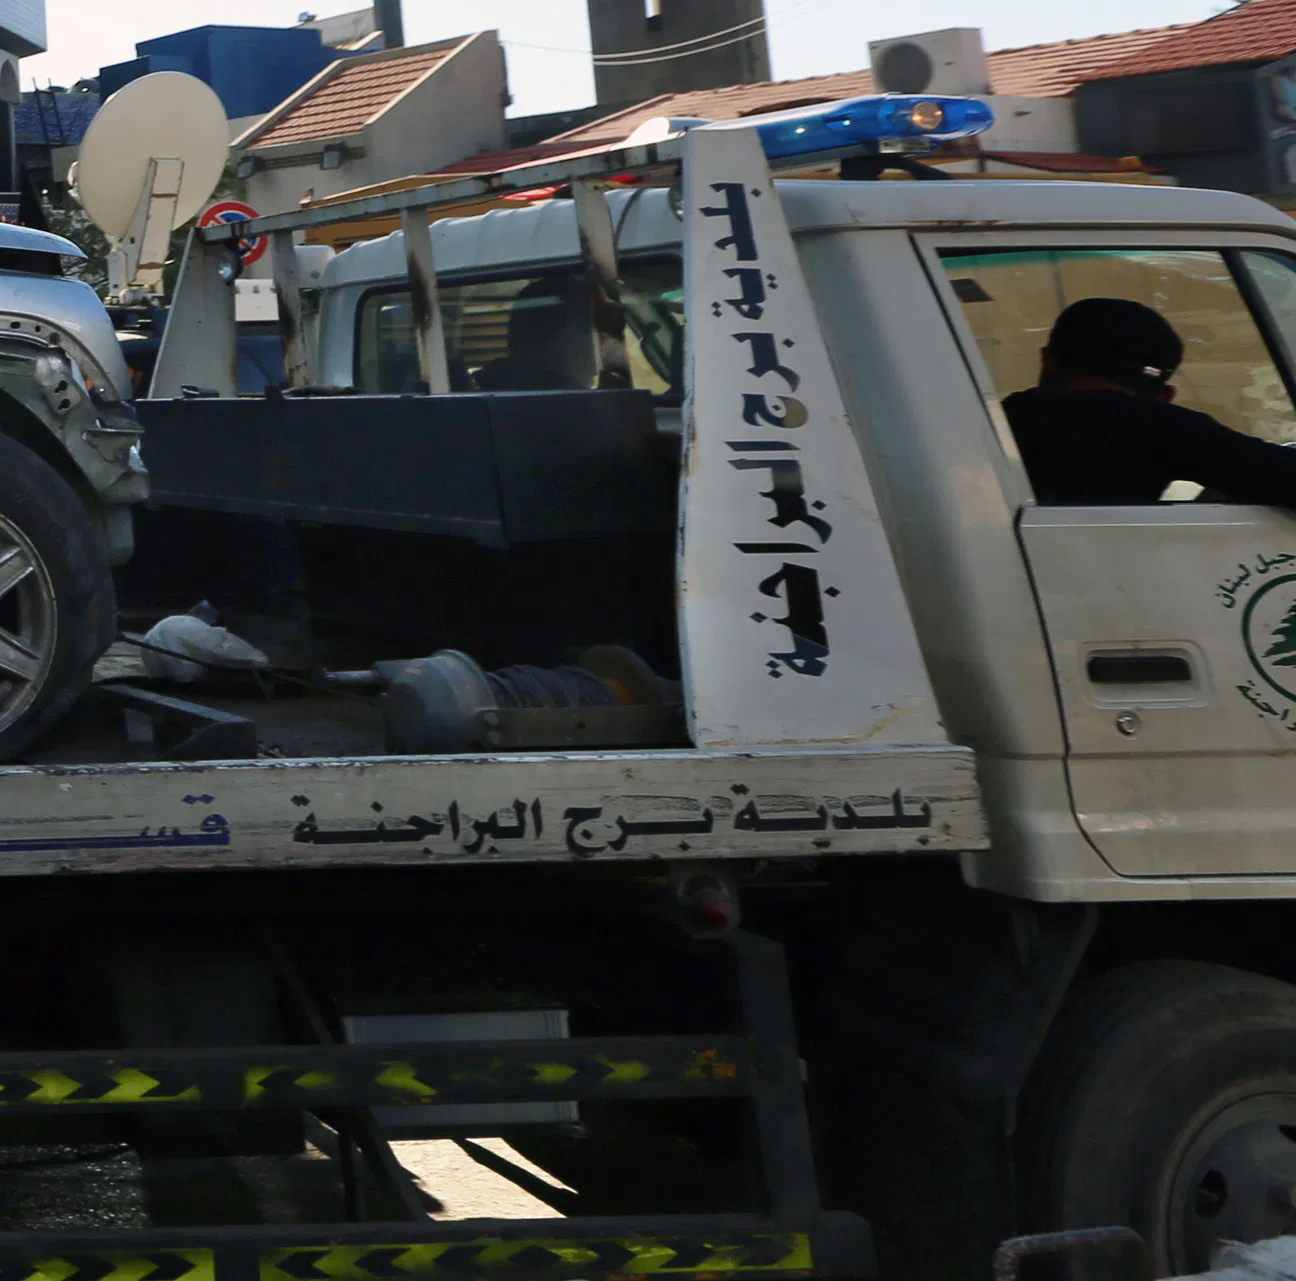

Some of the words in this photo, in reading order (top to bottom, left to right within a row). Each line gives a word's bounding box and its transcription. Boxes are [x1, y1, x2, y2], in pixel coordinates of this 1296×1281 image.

[698, 181, 779, 320] بلدية
[730, 331, 808, 429] برج
[723, 440, 842, 679] البراجنة
[1214, 563, 1251, 608] لبنان
[291, 794, 544, 856] البراجنة
[561, 803, 713, 858] برج
[729, 783, 933, 850] بلدية
